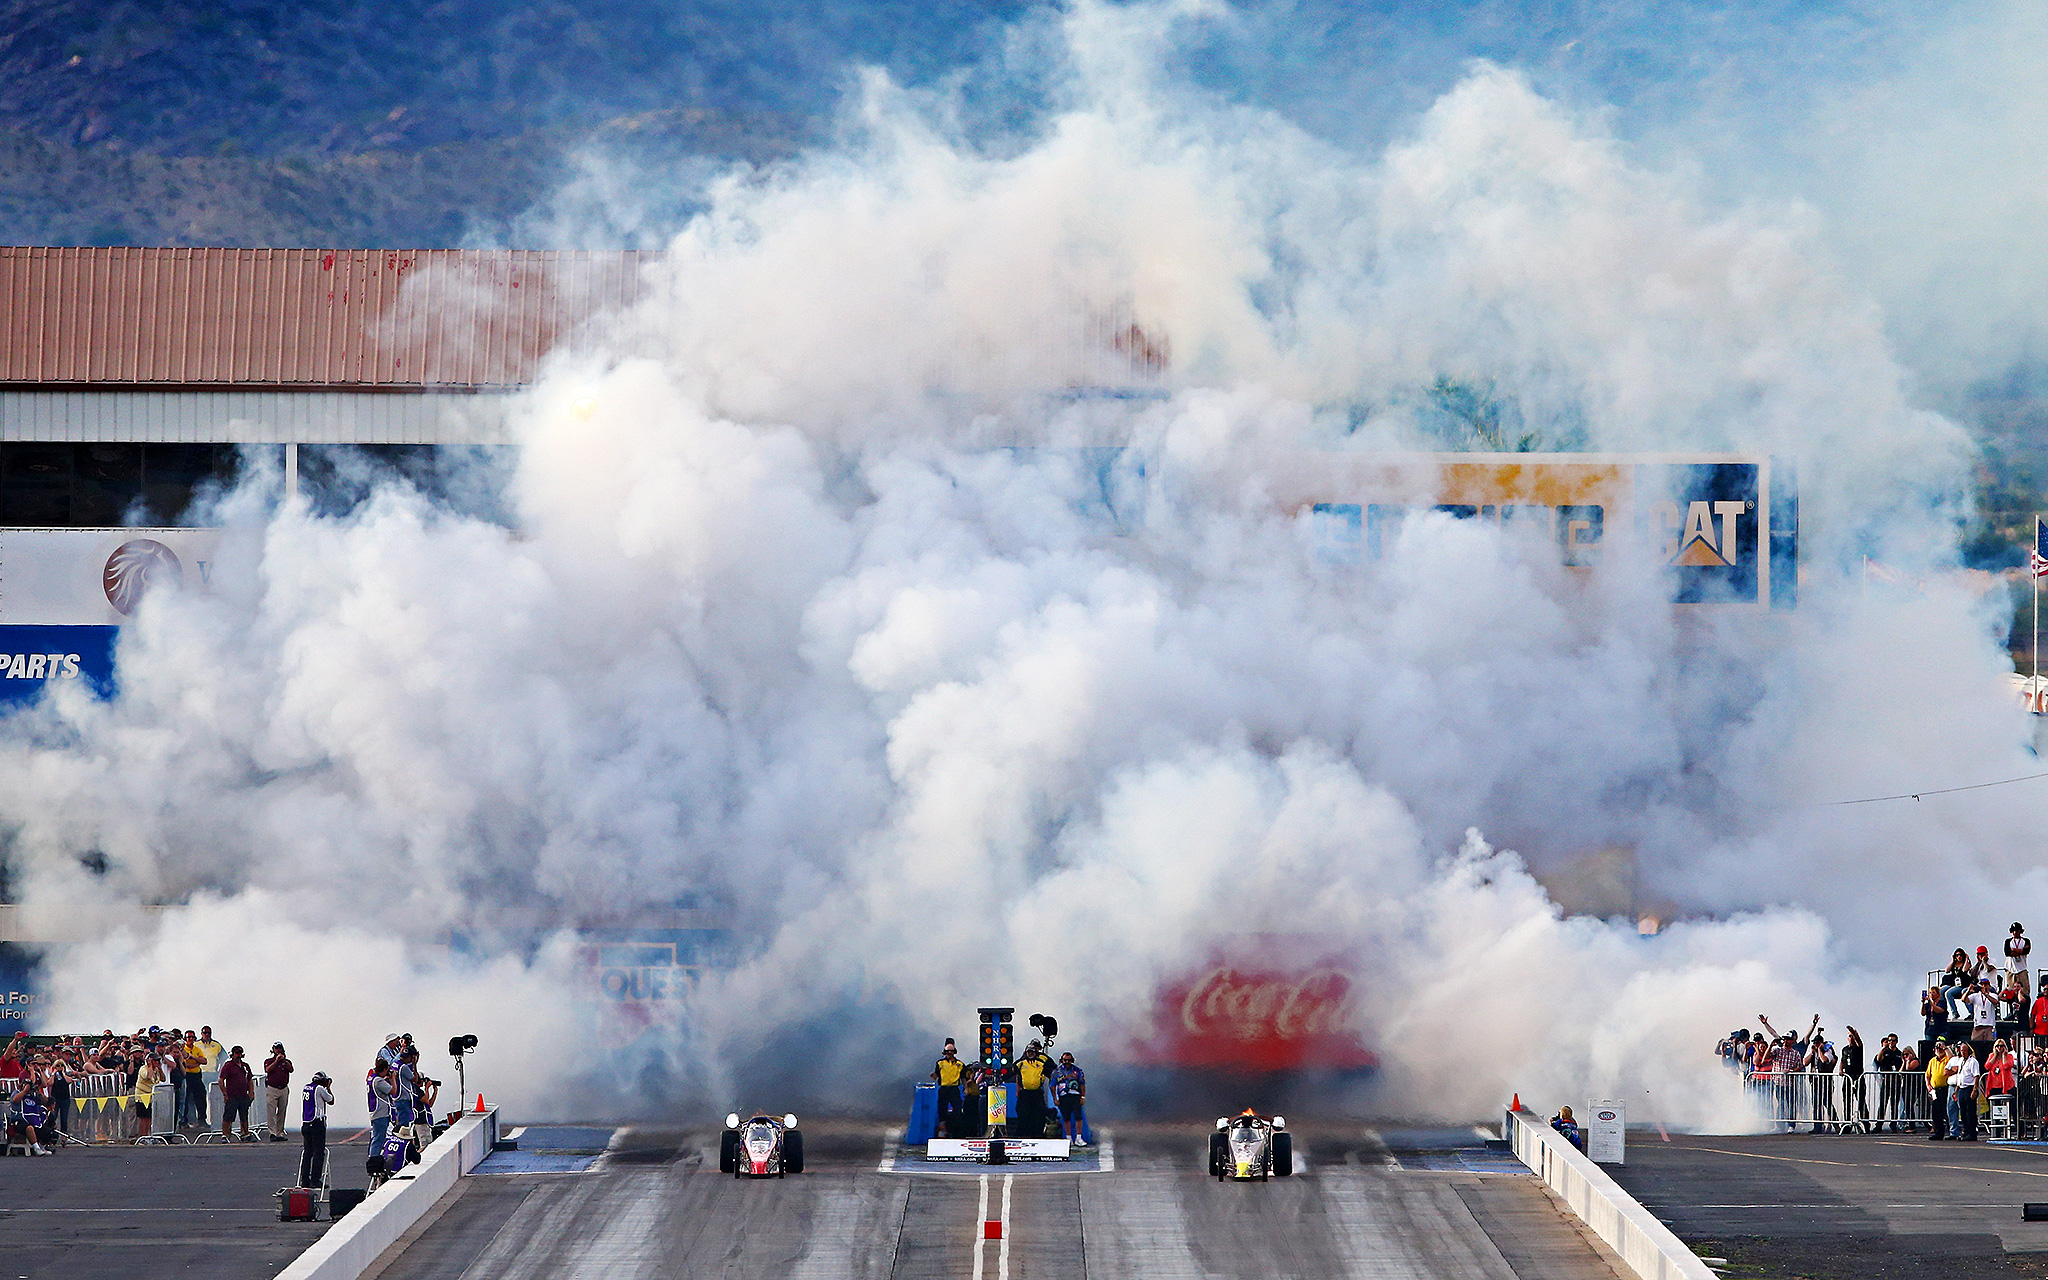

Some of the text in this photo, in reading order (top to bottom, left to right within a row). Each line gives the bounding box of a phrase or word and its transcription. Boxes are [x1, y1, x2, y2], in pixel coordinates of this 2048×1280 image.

[0, 653, 81, 679] PARTS
[992, 1029, 1000, 1060] NHRA
[387, 1142, 400, 1153] 60
